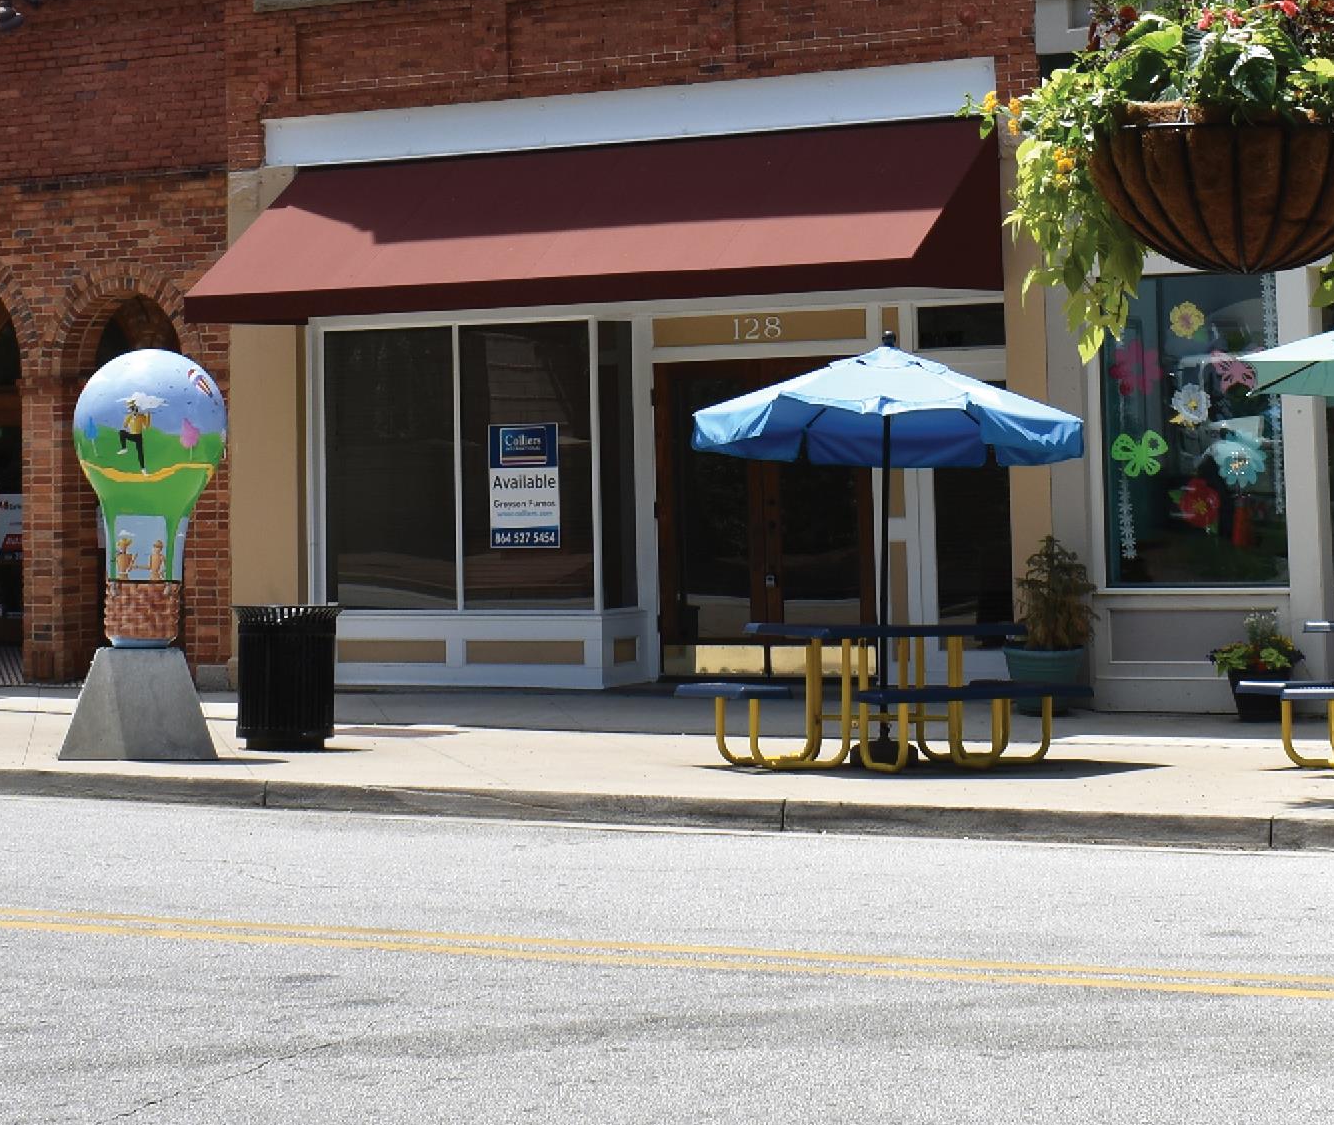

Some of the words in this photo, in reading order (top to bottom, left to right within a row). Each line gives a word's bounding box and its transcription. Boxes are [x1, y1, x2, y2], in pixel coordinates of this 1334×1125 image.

[733, 316, 781, 340] 128
[505, 434, 541, 446] Colliers
[493, 474, 556, 490] Available
[533, 531, 555, 543] 5454
